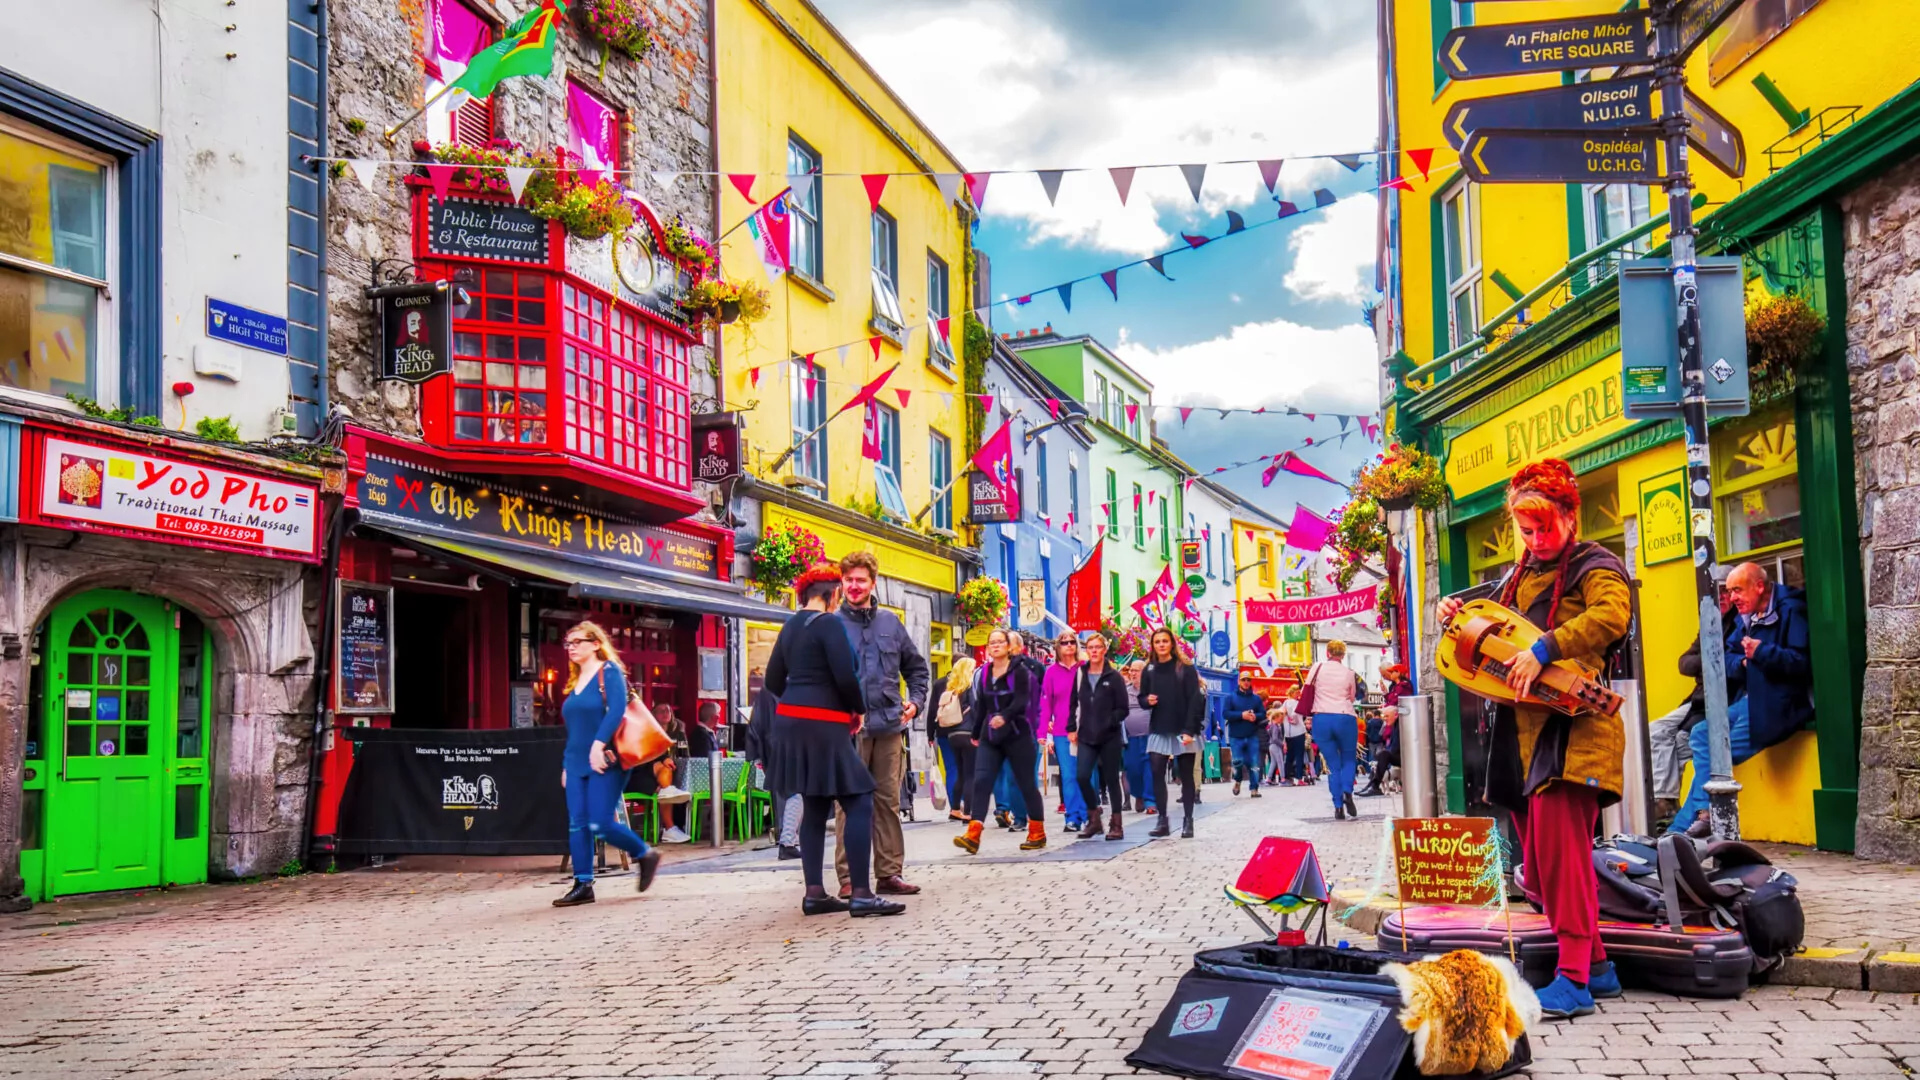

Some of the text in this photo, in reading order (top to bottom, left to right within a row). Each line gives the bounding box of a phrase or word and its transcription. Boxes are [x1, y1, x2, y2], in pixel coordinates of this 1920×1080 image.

[1505, 23, 1633, 47] An Fhaiche Mhór
[1521, 40, 1635, 63] EYRE SQUARE
[1580, 85, 1639, 105] Ollscoil
[1583, 103, 1641, 123] N.U.I.G.
[1583, 140, 1644, 156] Ospidéal
[1587, 158, 1646, 172] U.C.H.G.
[441, 208, 536, 234] Public House
[438, 229, 539, 252] & Restaurant
[395, 295, 431, 308] GUINNESS
[228, 323, 285, 347] HIGH STREET
[394, 361, 432, 375] HEAD
[1505, 371, 1623, 467] EVERGRE
[1456, 443, 1494, 476] HEALTH
[365, 472, 389, 488] Since
[699, 466, 727, 477] HEAD
[137, 461, 289, 514] Yod Pho
[368, 486, 387, 506] 1649
[115, 492, 300, 536] Traditional Thai Massage
[430, 482, 644, 558] The Kings Head
[973, 504, 1008, 516] BISTR
[1646, 498, 1683, 534] EVERGREEN
[162, 517, 258, 542] Tel: 089-2165894
[1648, 532, 1684, 552] CORNER
[1288, 604, 1309, 620] ON
[1310, 594, 1368, 618] GALWAY
[440, 747, 450, 755] PUB
[508, 746, 519, 754] BAR
[443, 792, 475, 804] HEAD
[1420, 820, 1438, 832] It's
[1400, 856, 1485, 874] If you want to take
[1436, 873, 1446, 885] be
[1411, 886, 1426, 899] Ask
[1427, 888, 1440, 898] and
[1441, 889, 1455, 899] TIP
